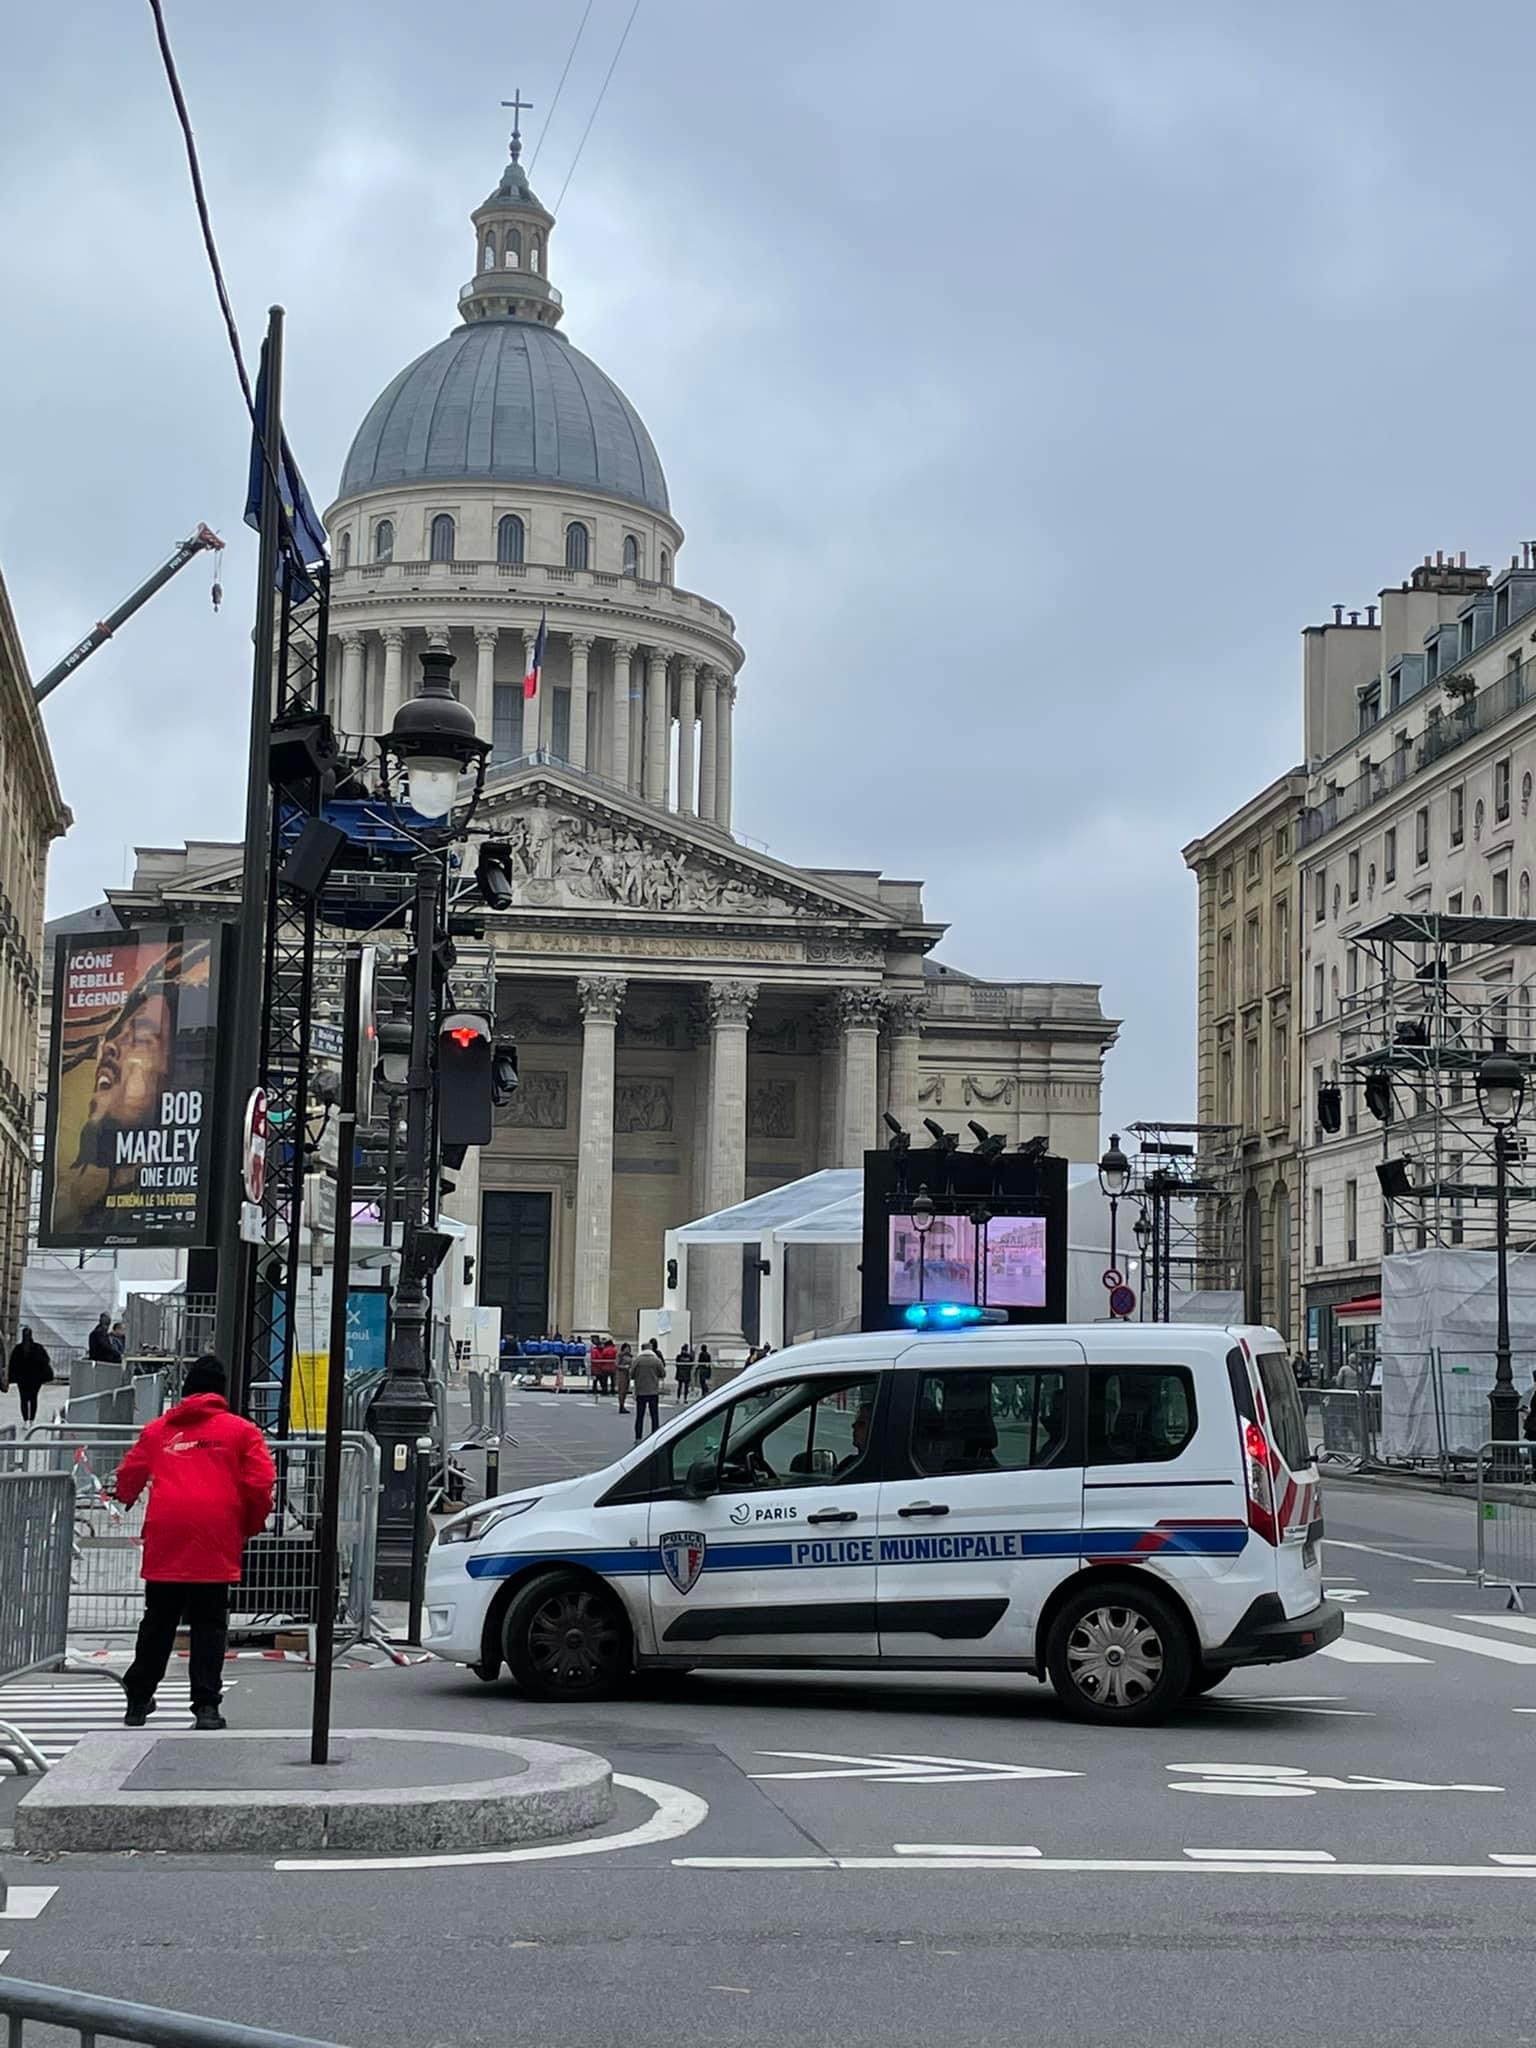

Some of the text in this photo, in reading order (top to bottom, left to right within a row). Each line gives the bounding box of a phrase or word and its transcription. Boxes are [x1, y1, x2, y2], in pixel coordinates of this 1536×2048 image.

[70, 951, 113, 970] ICÔNE
[70, 972, 125, 989] REBELLE
[69, 990, 128, 1008] LÉGENDE
[160, 1090, 203, 1125] BOB
[115, 1128, 200, 1164] MARLEY
[140, 1166, 199, 1187] ONE LOVE
[105, 1195, 116, 1208] AU
[117, 1192, 145, 1208] CINÉMA
[145, 1194, 155, 1207] LE
[166, 1191, 197, 1206] FÉVRIER
[755, 1506, 798, 1521] PARIS
[663, 1532, 702, 1544] POLICE
[796, 1535, 1017, 1564] POLICE MUNICIPALE
